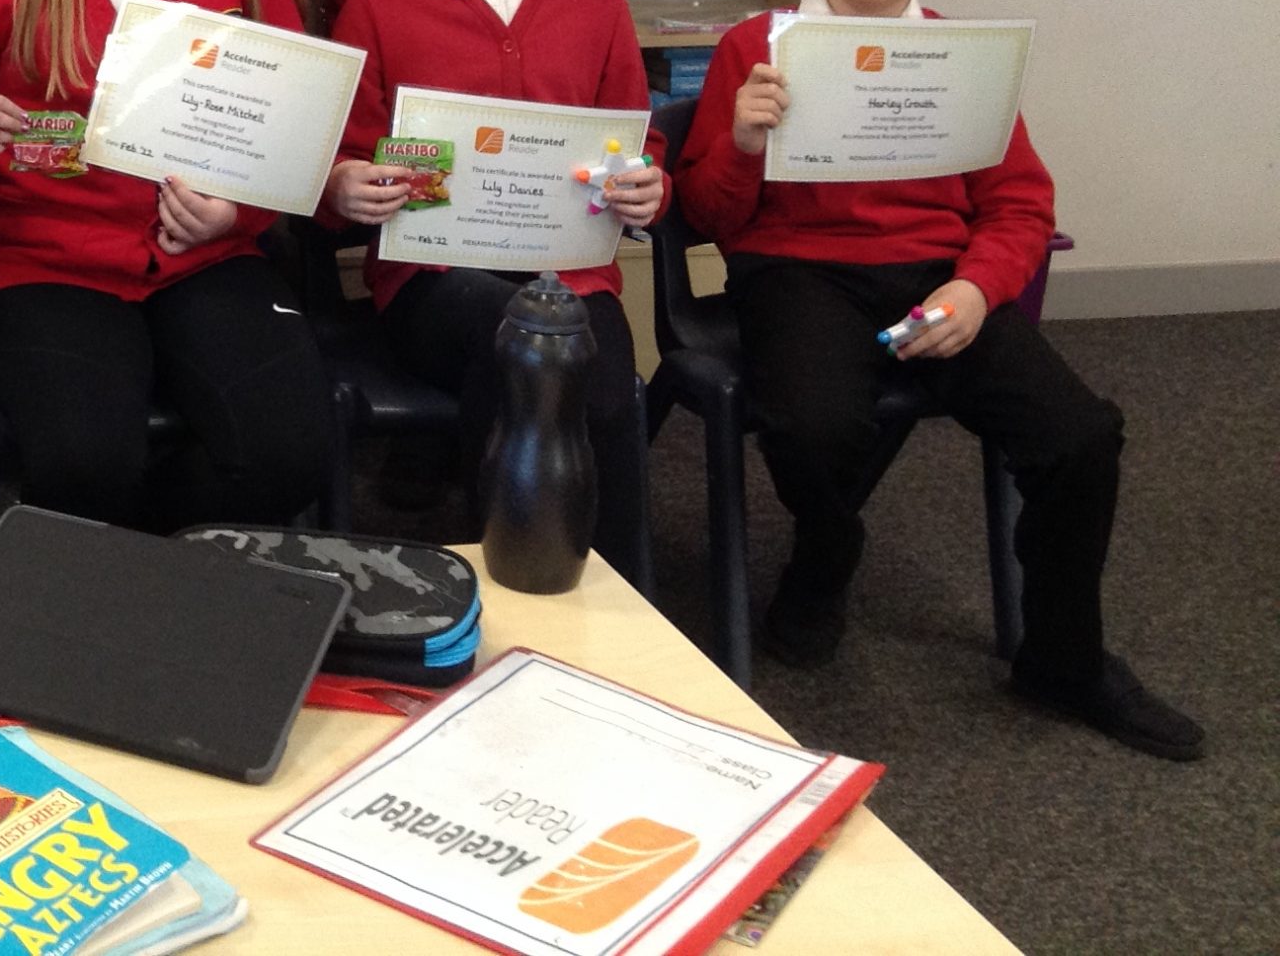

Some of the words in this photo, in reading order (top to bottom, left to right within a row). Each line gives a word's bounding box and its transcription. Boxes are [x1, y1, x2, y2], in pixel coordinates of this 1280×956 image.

[223, 50, 278, 72] Accelerated
[891, 51, 949, 60] Accelerated
[182, 78, 196, 86] This
[196, 81, 229, 96] certificate
[236, 92, 265, 106] awarded
[181, 92, 225, 113] Lily-Rose
[227, 104, 265, 124] Mitchell
[868, 97, 902, 114] Harley
[382, 142, 440, 158] HARIBO
[509, 134, 566, 147] Accelerated
[472, 166, 485, 174] This
[486, 167, 519, 177] certificate
[527, 171, 554, 180] awarded
[482, 180, 503, 196] Lily
[509, 182, 544, 197] Davies
[478, 787, 587, 846] Reader
[351, 789, 542, 877] Accelerated
[9, 854, 141, 956] AZTECS
